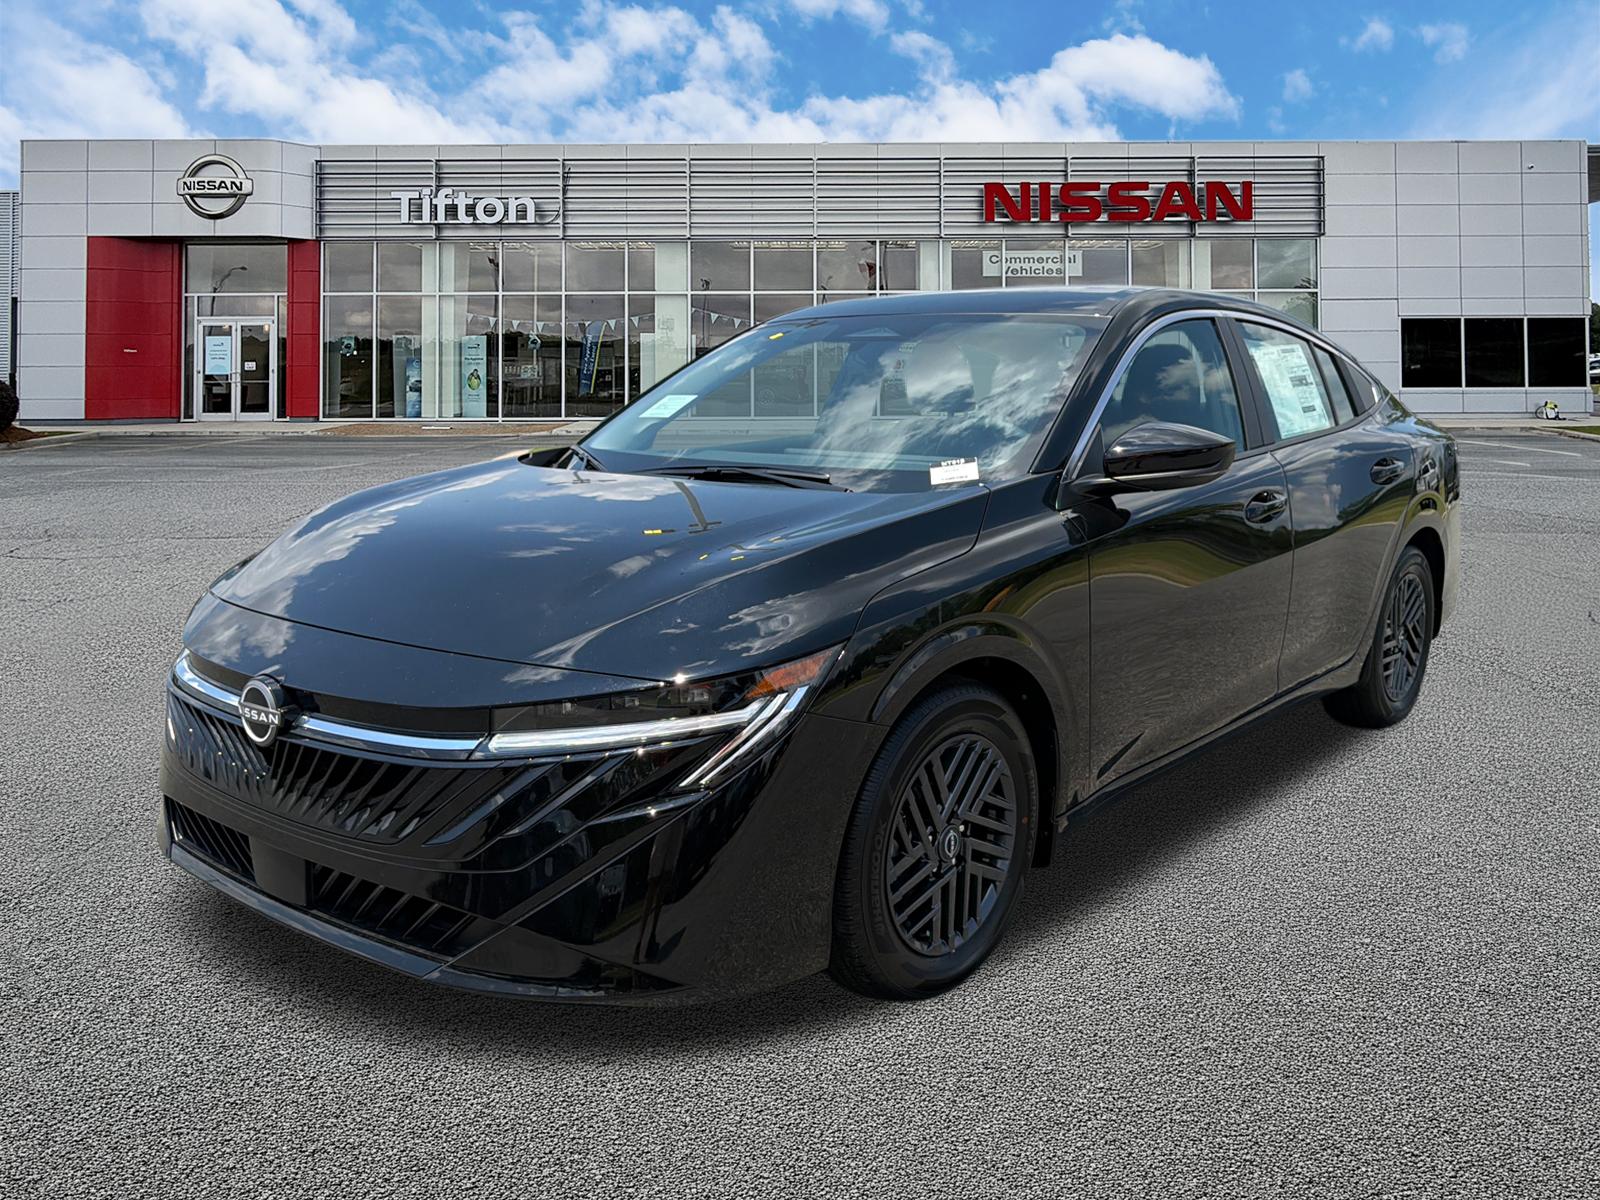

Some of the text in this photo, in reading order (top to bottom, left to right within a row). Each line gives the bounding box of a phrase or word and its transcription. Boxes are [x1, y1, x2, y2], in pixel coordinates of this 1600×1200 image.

[183, 181, 243, 191] NISSAN
[391, 188, 536, 224] Tifton
[984, 181, 1253, 222] NISSAN
[241, 706, 279, 725] SSAN
